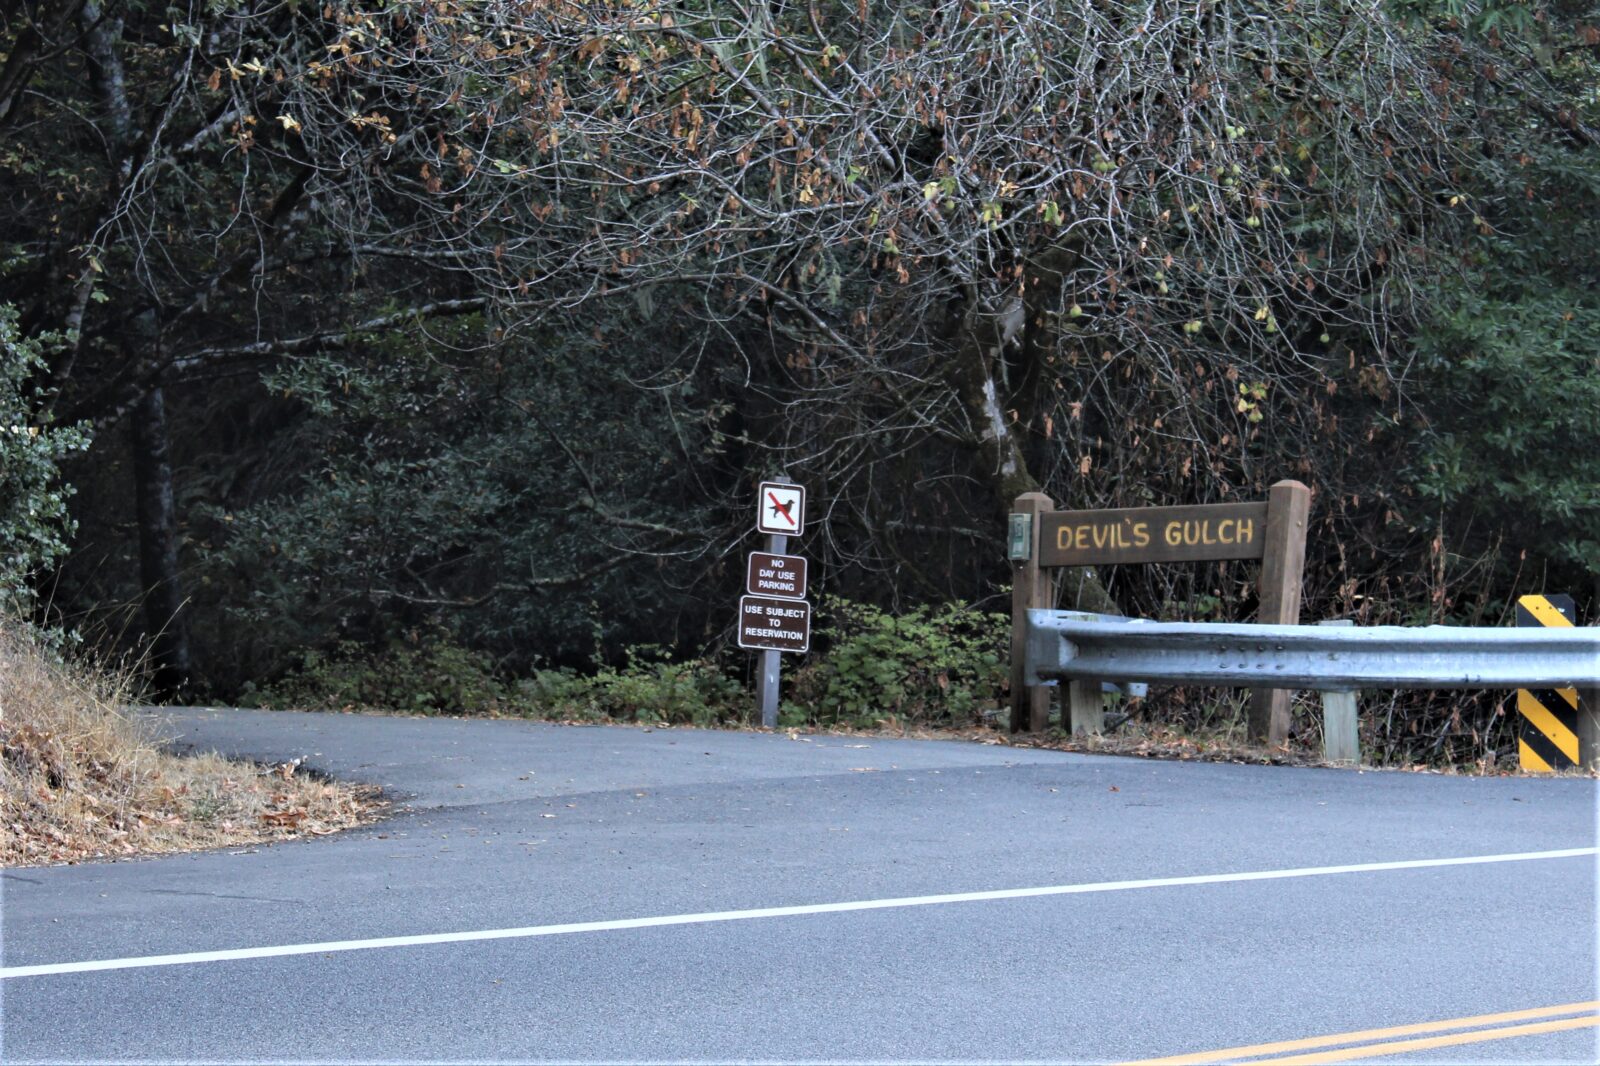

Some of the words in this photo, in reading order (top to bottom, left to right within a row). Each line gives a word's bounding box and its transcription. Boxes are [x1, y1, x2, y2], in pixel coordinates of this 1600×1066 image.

[1057, 517, 1150, 549] DEVIL'S
[1165, 519, 1253, 545] GULCH
[771, 559, 784, 568] NO
[760, 569, 775, 578] DAY
[778, 571, 795, 580] USE
[759, 580, 794, 591] PARKING
[745, 605, 763, 614] USE
[766, 607, 805, 618] SUBJECT
[769, 618, 781, 627] TO
[745, 627, 803, 640] RESERVATION
